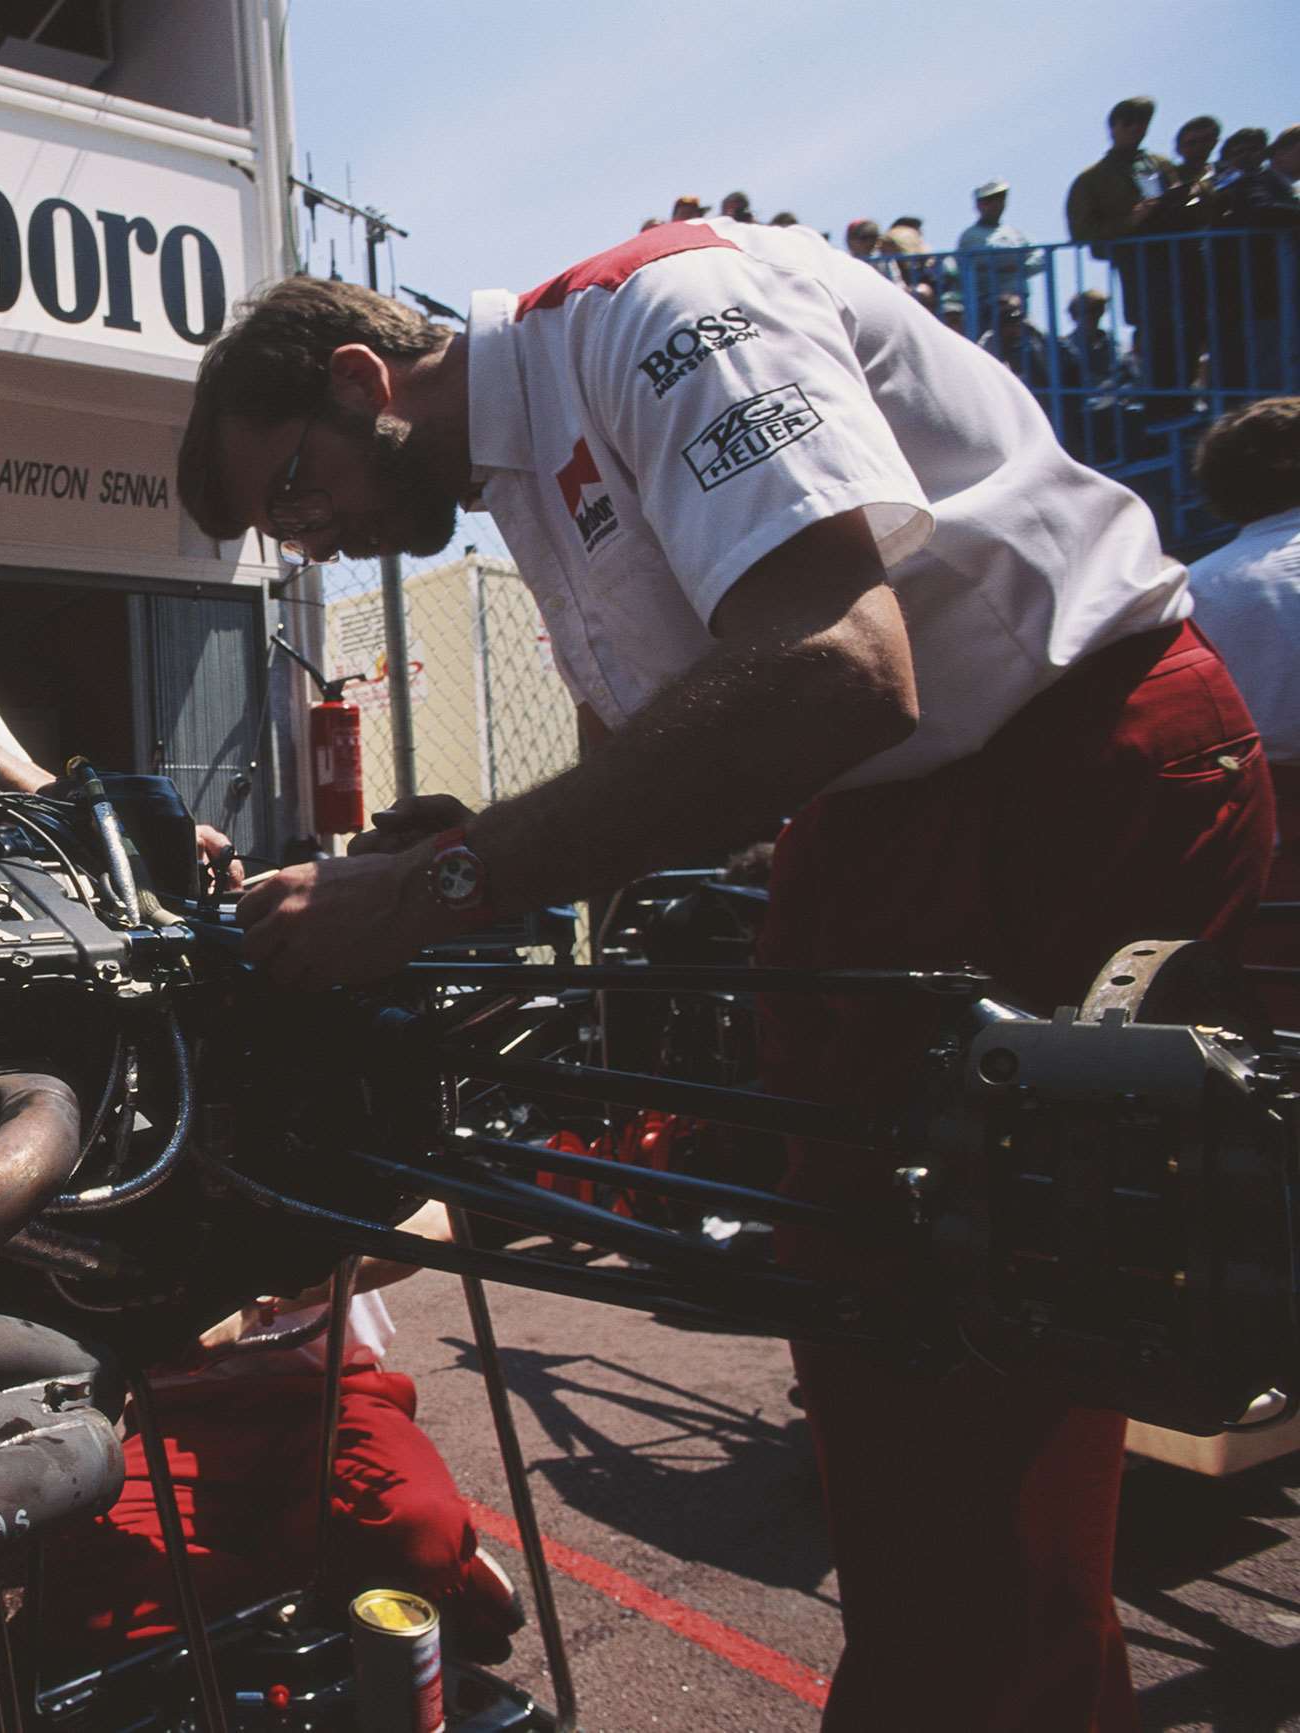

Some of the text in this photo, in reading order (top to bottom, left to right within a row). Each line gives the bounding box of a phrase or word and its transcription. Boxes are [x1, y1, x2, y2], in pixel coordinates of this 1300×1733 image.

[638, 306, 751, 386] BOSS
[710, 416, 805, 478] HEUER
[100, 469, 169, 509] SENNA
